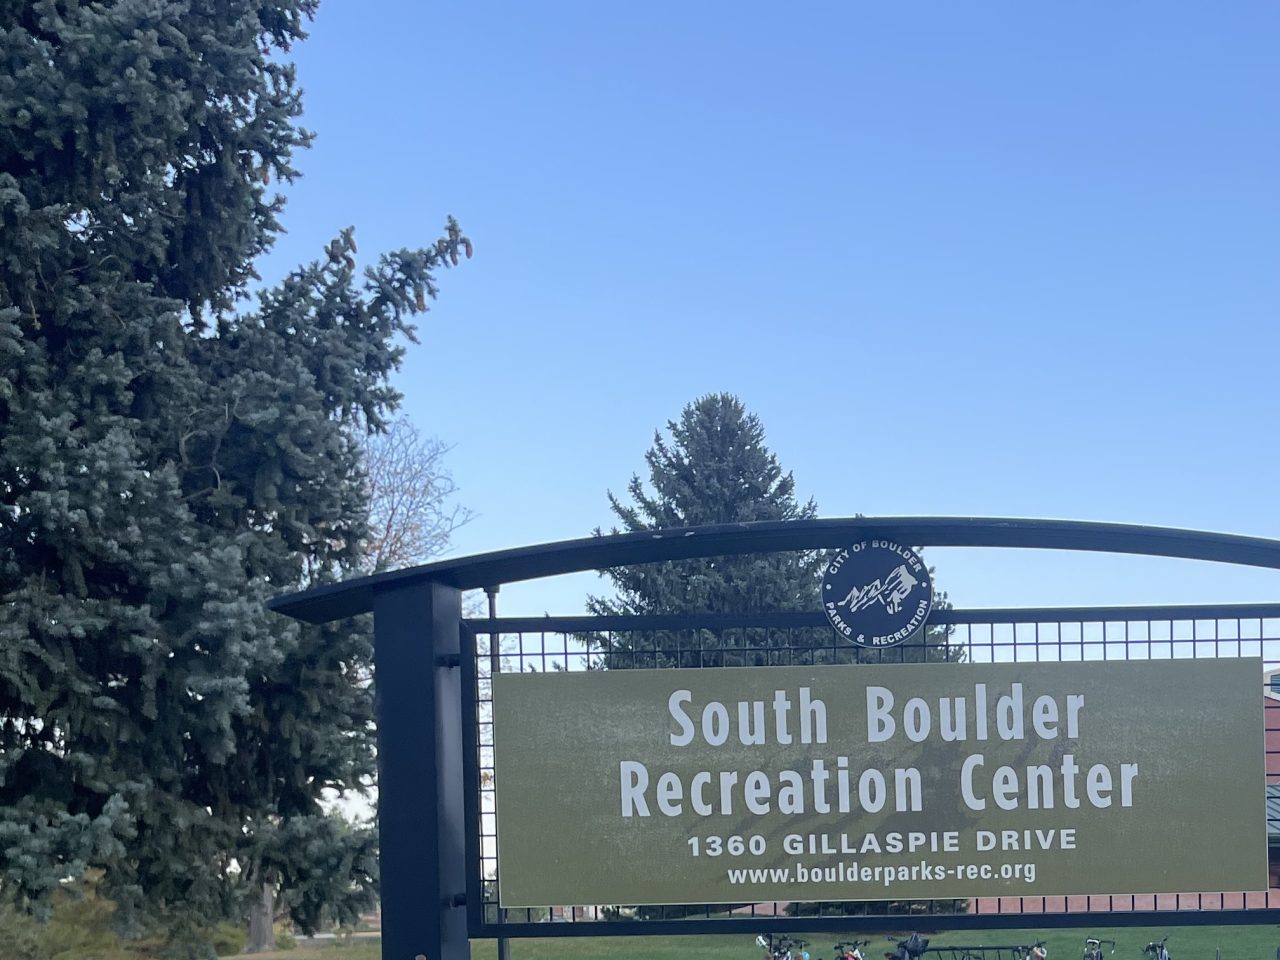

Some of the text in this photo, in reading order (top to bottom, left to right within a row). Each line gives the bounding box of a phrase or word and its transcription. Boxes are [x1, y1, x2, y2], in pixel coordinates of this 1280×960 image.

[829, 539, 922, 574] CITY OF BOULDER
[826, 599, 928, 645] PARKS & RECREATION
[668, 682, 1085, 747] South Boulder
[619, 753, 1139, 818] Recreation Center
[687, 828, 1077, 857] 1360 GILLASPIE DRIVE
[727, 860, 1036, 887] www.boulderparks-rec.org
